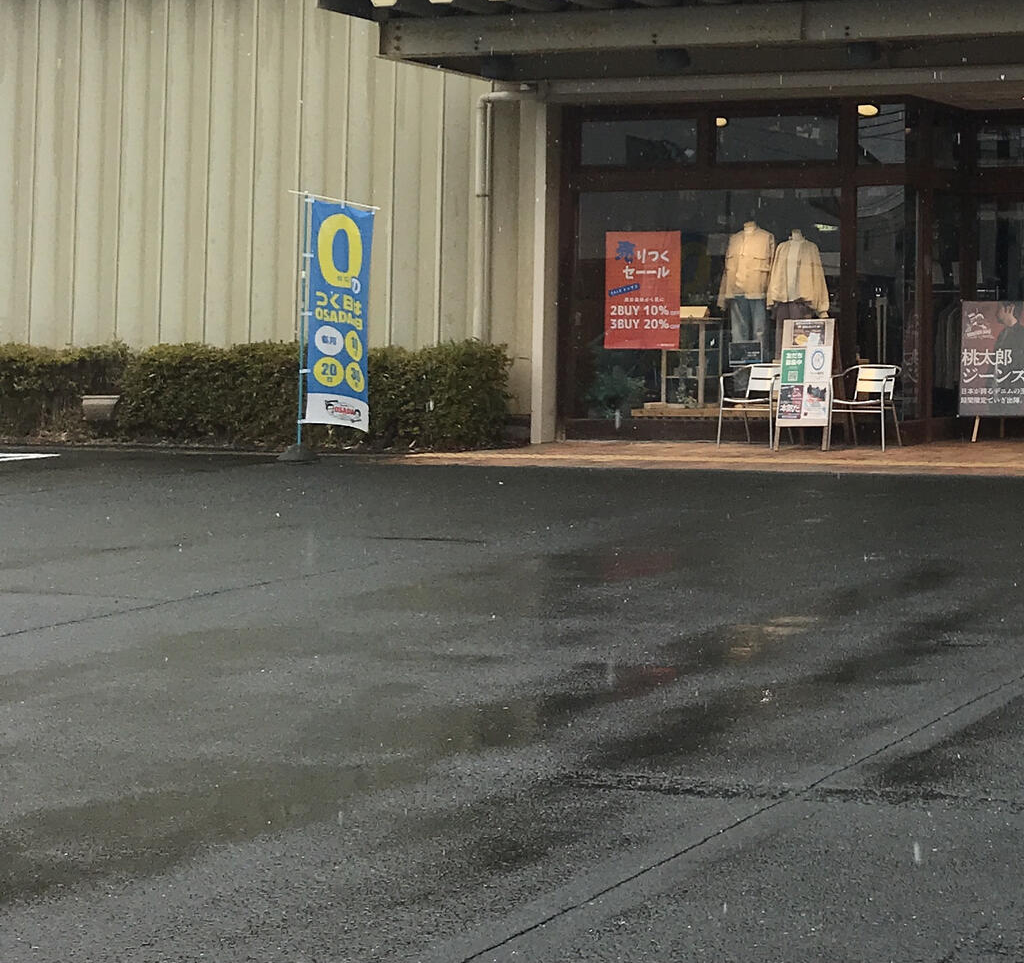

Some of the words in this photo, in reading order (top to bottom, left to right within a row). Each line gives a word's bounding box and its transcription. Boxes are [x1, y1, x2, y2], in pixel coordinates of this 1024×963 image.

[610, 305, 640, 316] 2BUY
[610, 319, 640, 329] 3BUY
[962, 348, 1012, 366] 桃太郎
